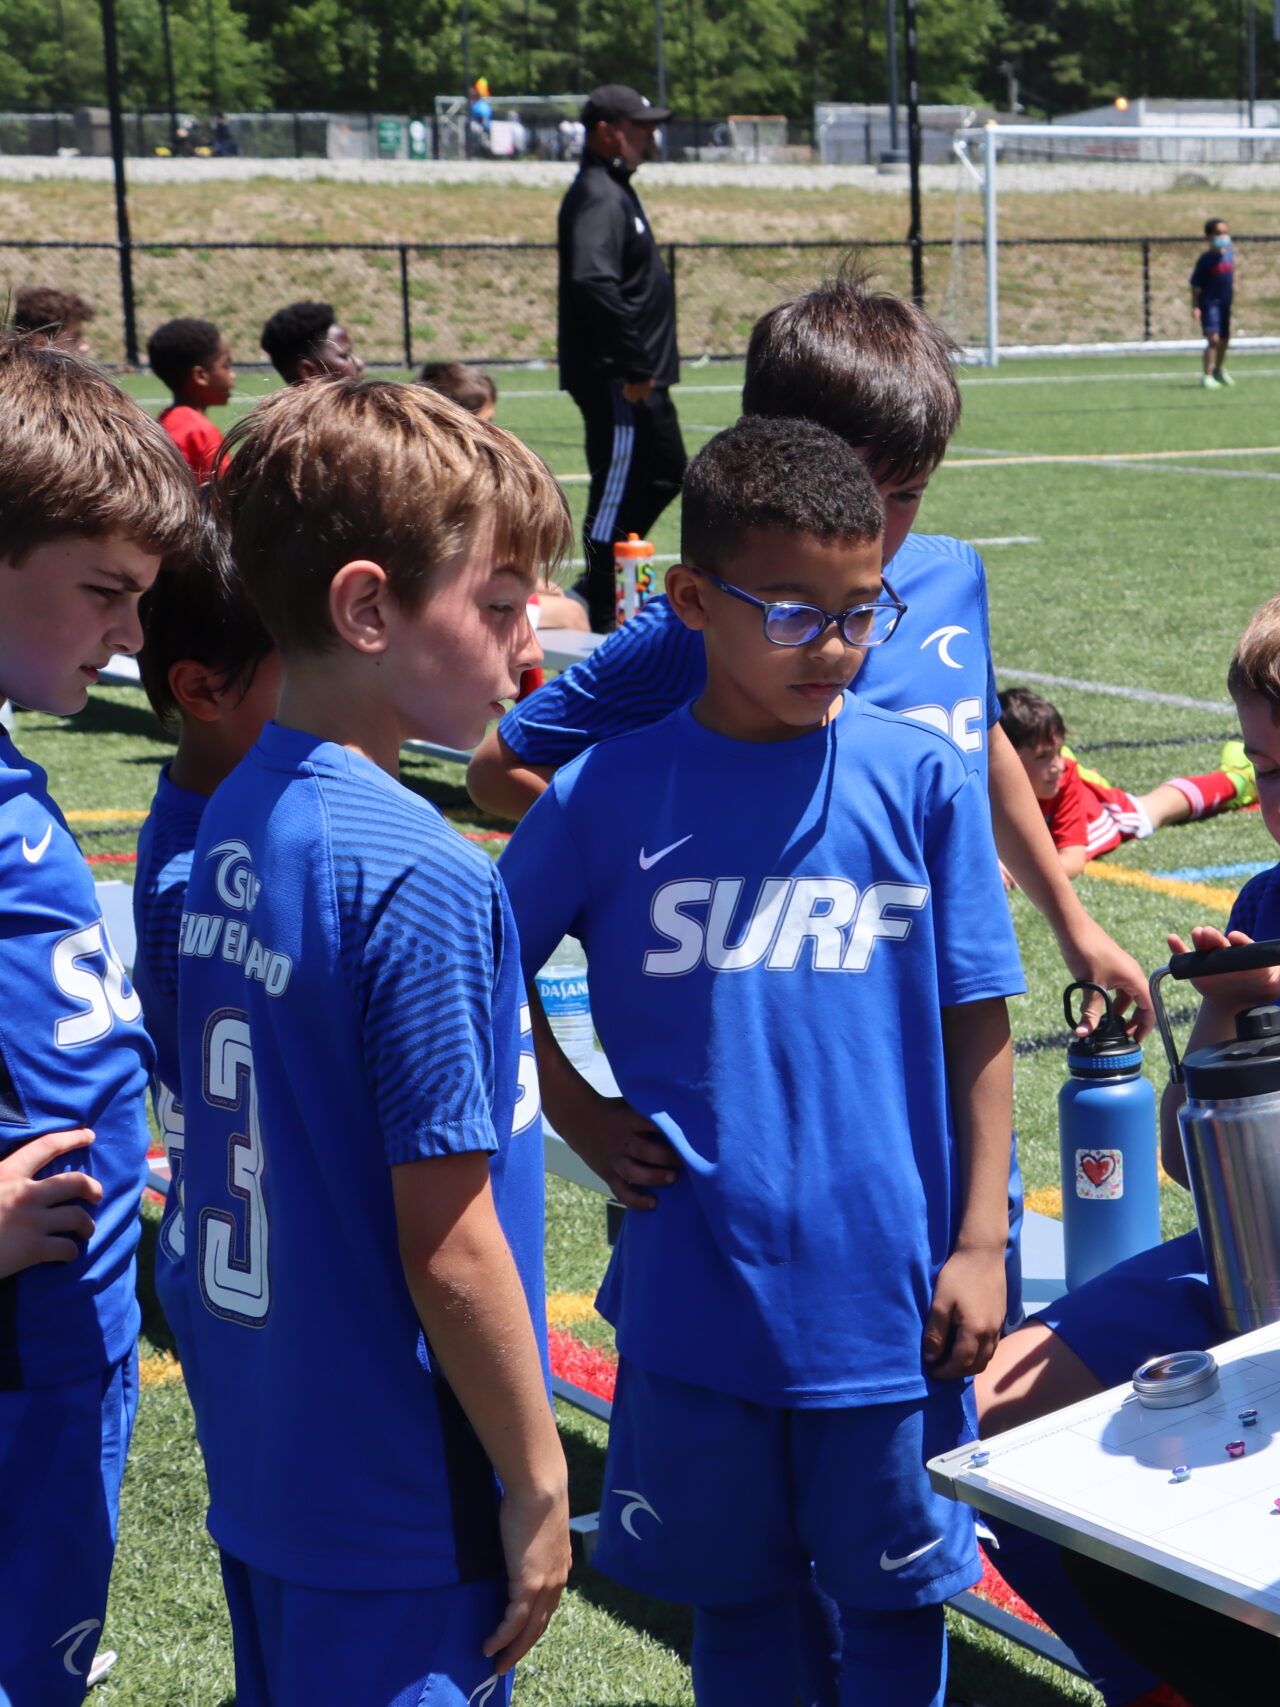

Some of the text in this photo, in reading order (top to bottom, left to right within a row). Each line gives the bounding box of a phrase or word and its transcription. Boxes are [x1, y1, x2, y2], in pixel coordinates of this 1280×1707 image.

[642, 876, 930, 977] SURF
[541, 981, 589, 1000] DASAN
[199, 1006, 271, 1330] 3
